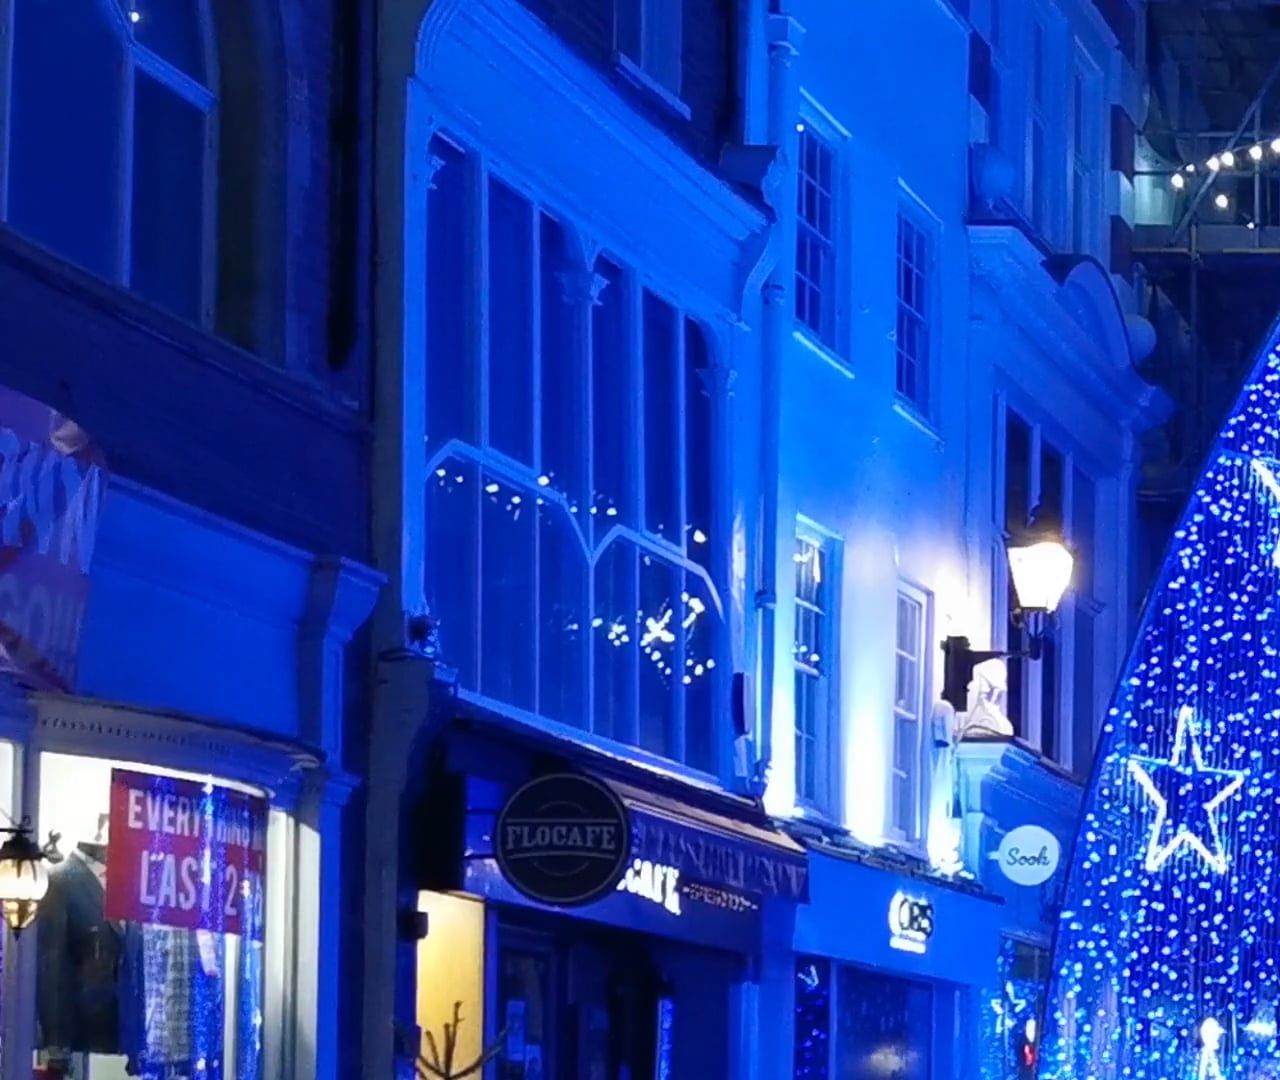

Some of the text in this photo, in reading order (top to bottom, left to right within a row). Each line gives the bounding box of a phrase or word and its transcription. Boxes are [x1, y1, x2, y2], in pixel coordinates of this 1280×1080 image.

[127, 788, 250, 849] EVERYTHING
[506, 824, 616, 851] FLOCAFE
[139, 849, 217, 913] LAST
[224, 863, 238, 917] 2
[1006, 845, 1051, 867] Sook
[616, 857, 682, 916] CAFE
